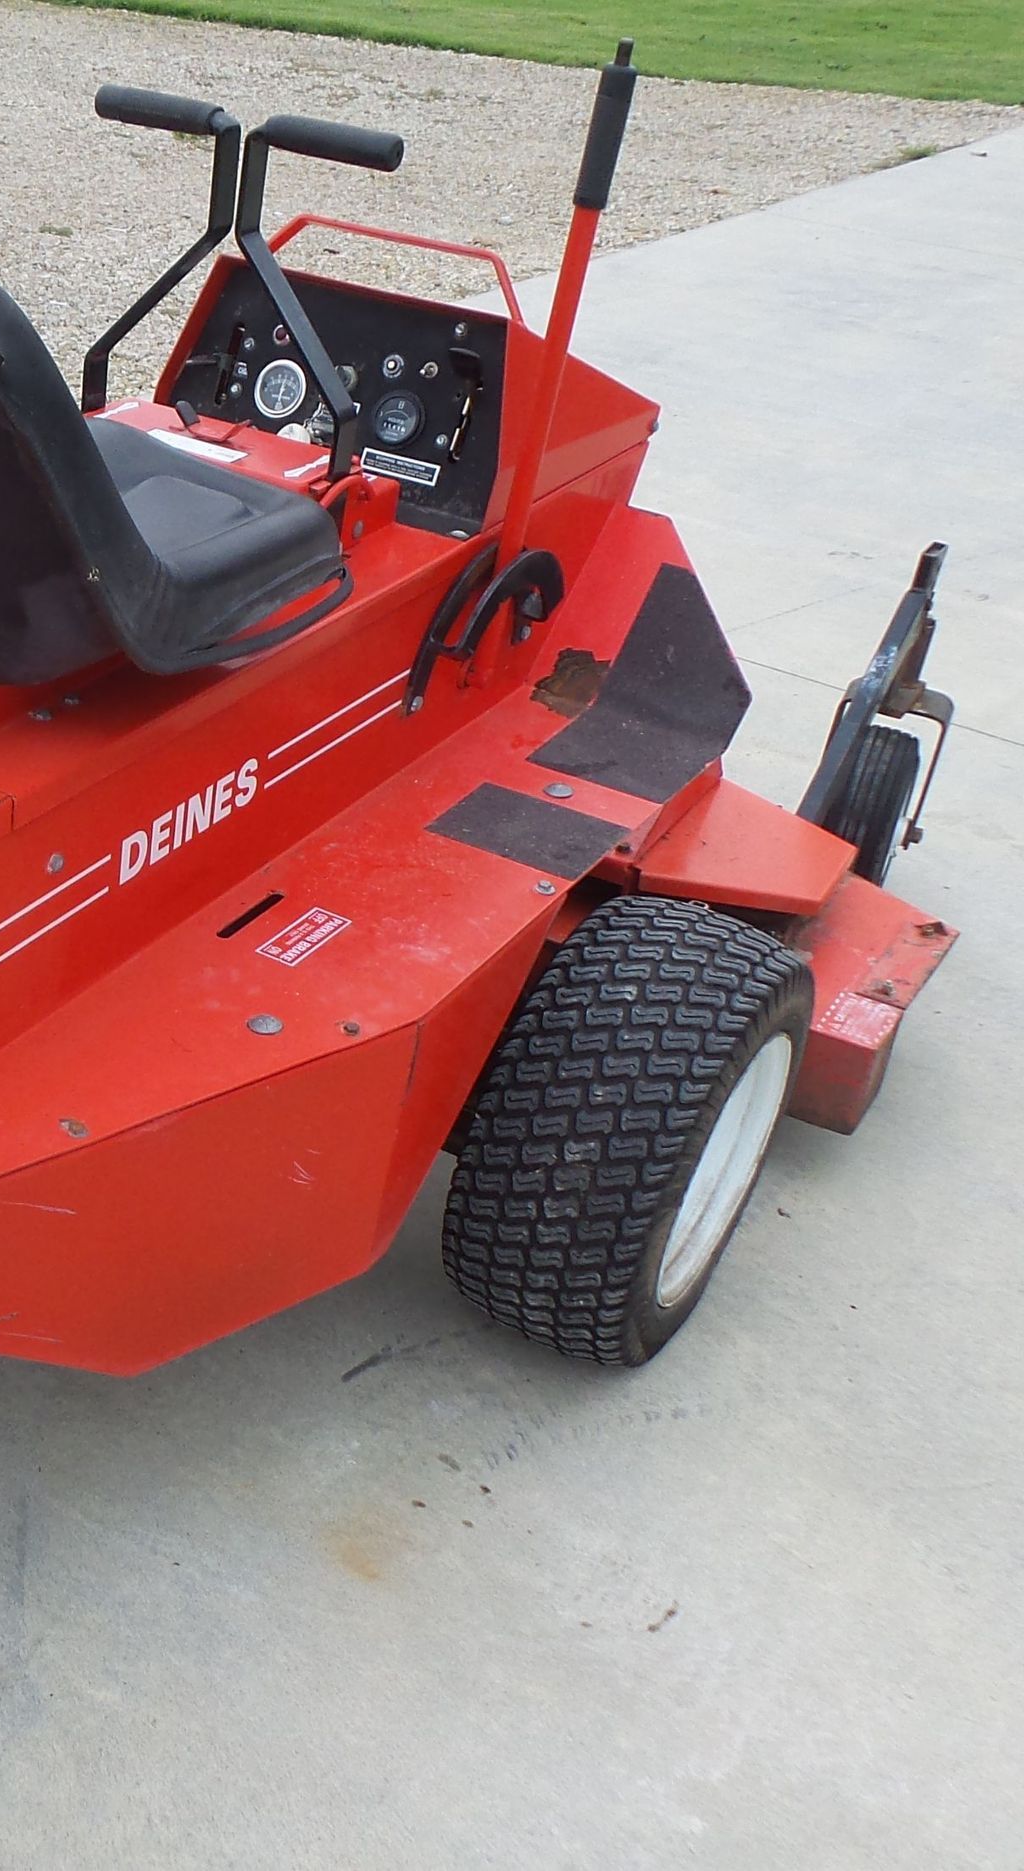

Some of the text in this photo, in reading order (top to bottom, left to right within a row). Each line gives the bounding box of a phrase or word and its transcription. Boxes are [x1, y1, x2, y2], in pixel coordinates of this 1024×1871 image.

[119, 758, 258, 885] DEINES
[305, 918, 344, 943] PARKING
[279, 940, 311, 962] BRAKE
